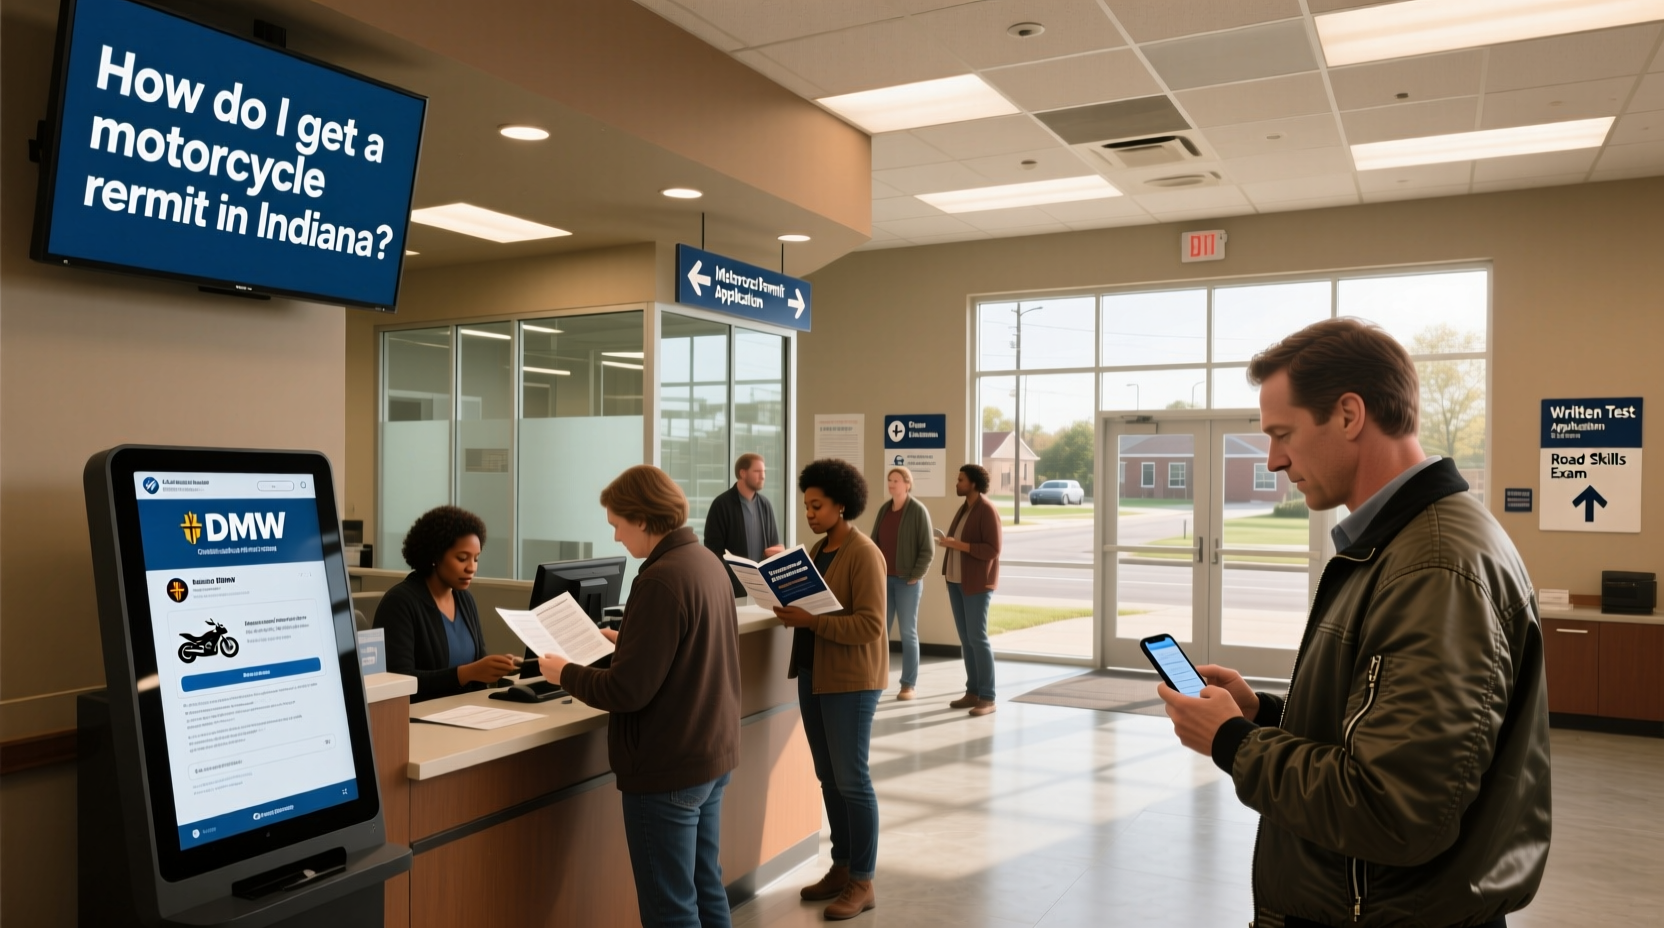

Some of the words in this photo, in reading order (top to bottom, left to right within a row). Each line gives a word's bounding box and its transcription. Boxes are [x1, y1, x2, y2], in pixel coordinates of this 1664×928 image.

[97, 45, 205, 113] How
[214, 83, 267, 129] do
[277, 98, 290, 136] I
[296, 114, 357, 156] get
[364, 134, 384, 163] a
[90, 116, 326, 197] motorcycle
[84, 176, 209, 227] rermit
[217, 194, 248, 235] in
[257, 202, 393, 260] Indiana?
[1605, 405, 1636, 419] Test
[1551, 453, 1586, 465] Road
[1589, 452, 1627, 466] Skills
[1551, 467, 1587, 479] Exam
[204, 511, 286, 542] DMW
